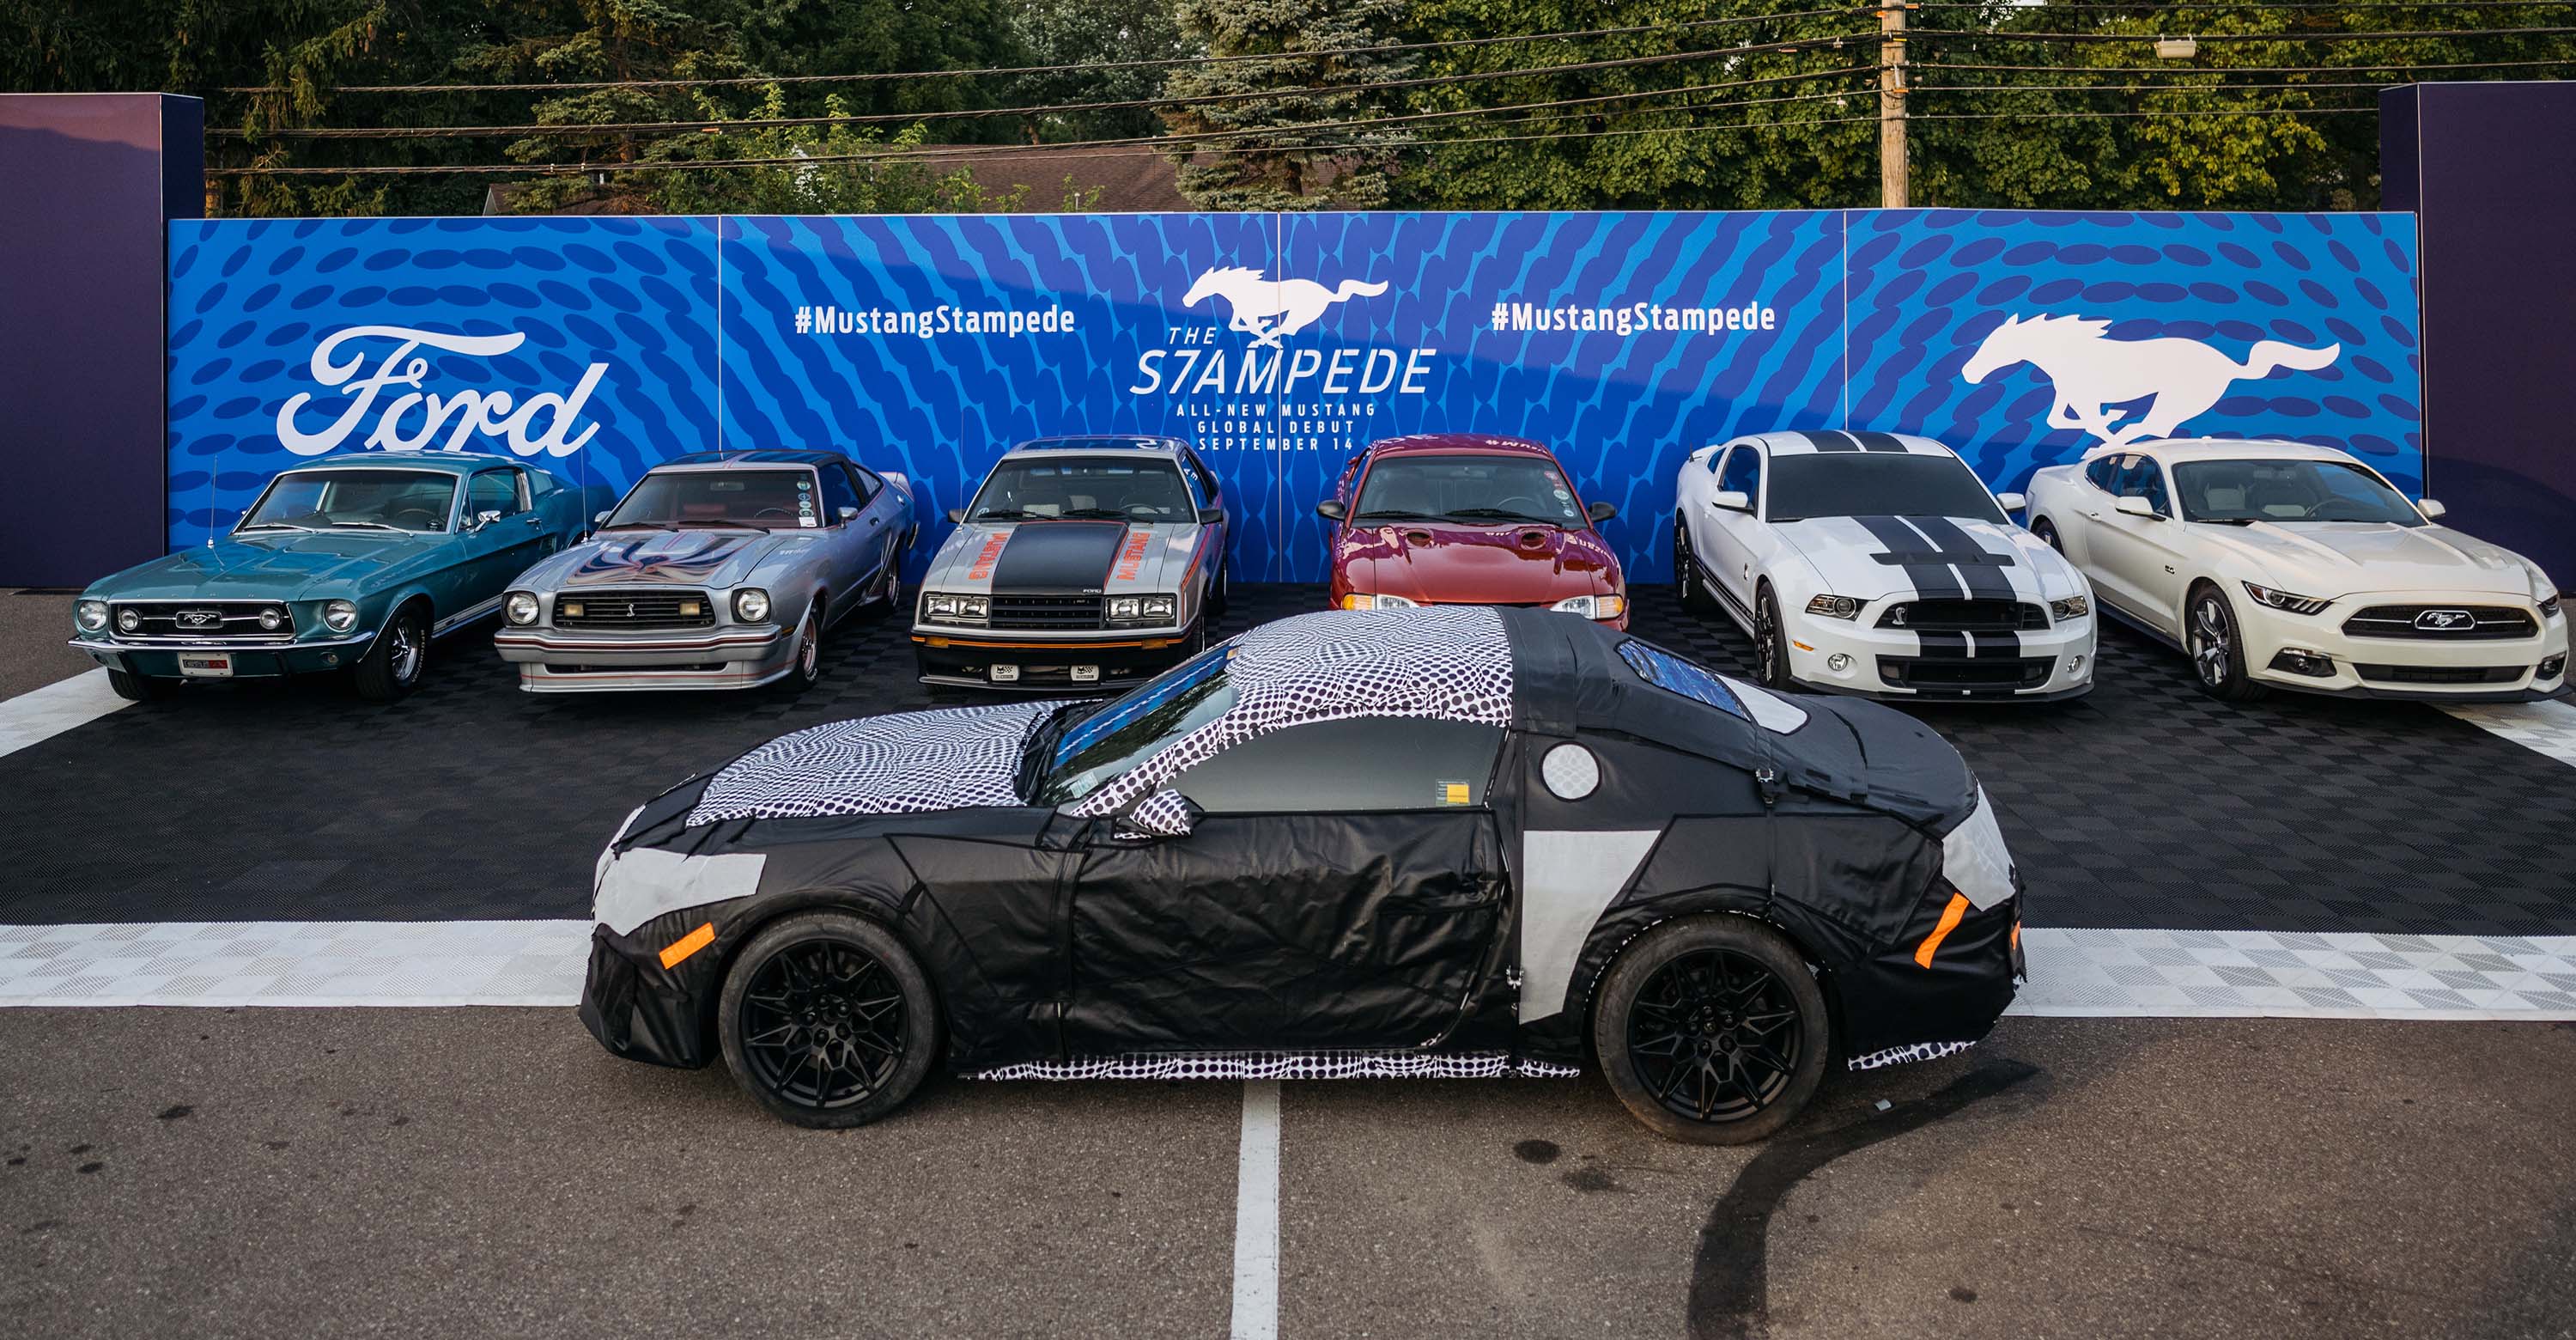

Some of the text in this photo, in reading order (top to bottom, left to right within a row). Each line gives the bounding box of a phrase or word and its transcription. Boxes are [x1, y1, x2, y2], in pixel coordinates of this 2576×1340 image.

[796, 305, 1074, 338] #MustangStampede
[1170, 327, 1217, 344] THE
[1492, 302, 1775, 336] #MustangStampede
[276, 326, 610, 458] Ford
[1176, 404, 1375, 417] ALL-NEW MUSTANG
[1198, 421, 1353, 434] GLOBAL DEBUT
[1199, 438, 1353, 451] SEPTEMBER 14
[968, 532, 1010, 580] MUSTANG
[1116, 532, 1151, 581] MUSTANG
